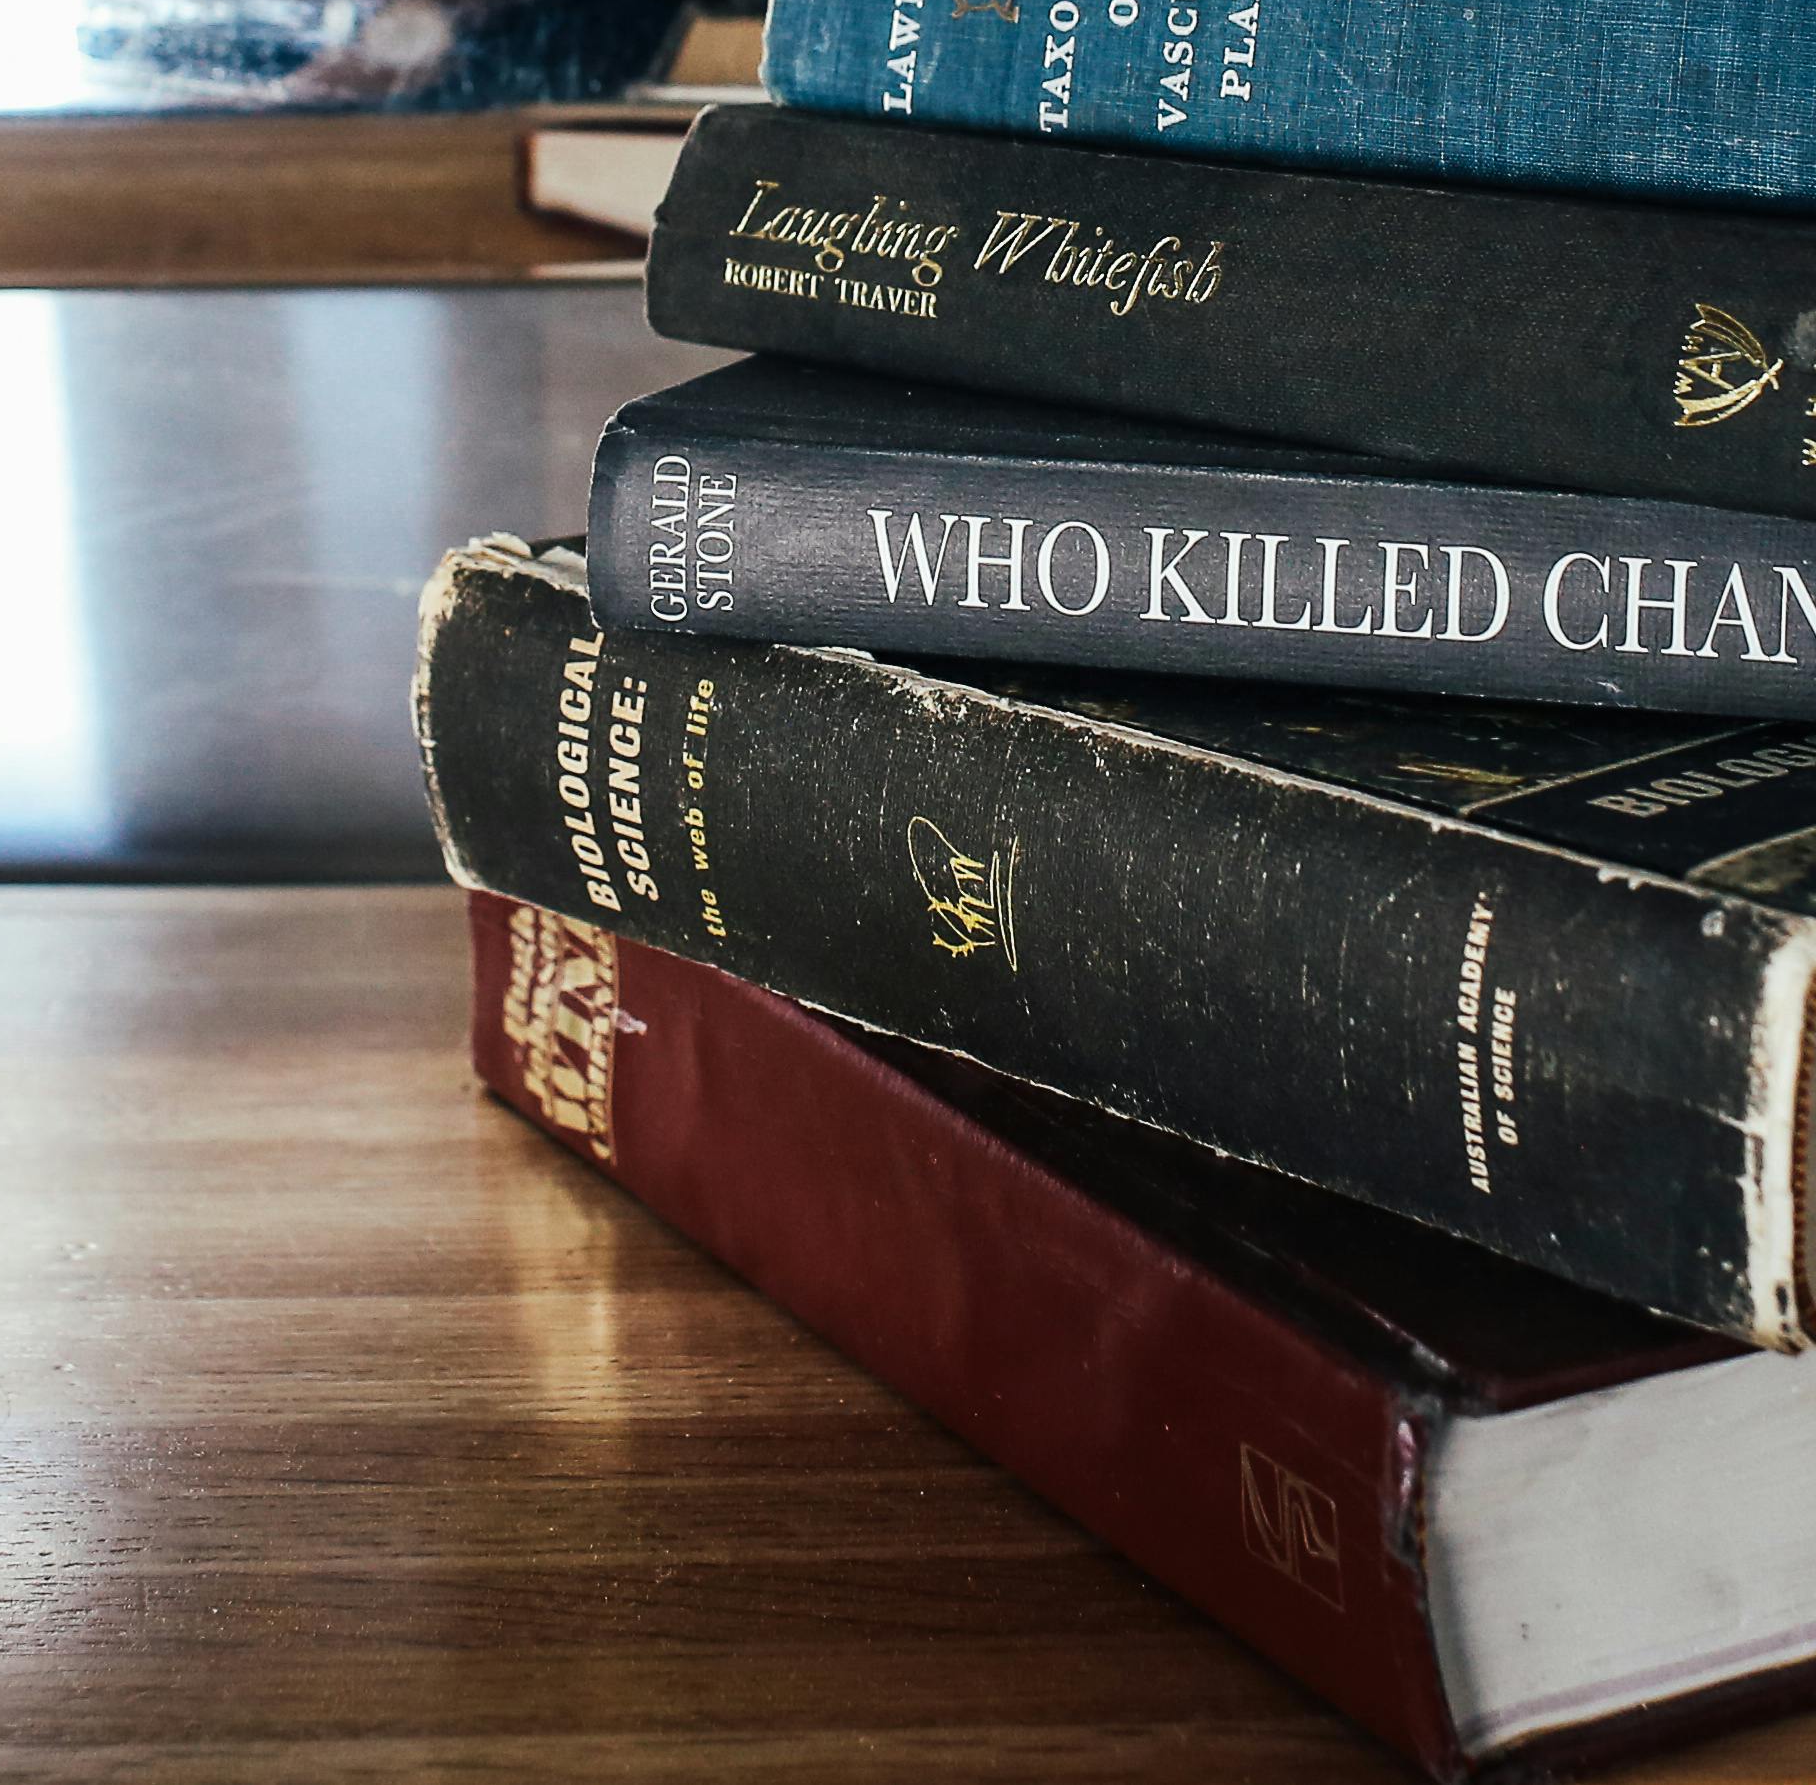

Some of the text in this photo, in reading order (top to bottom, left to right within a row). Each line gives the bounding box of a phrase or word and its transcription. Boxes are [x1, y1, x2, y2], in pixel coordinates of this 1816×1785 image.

[723, 257, 938, 318] ROBERT TRAVER
[729, 179, 1224, 316] Laughing Whitefish
[650, 454, 692, 622] GERALD
[696, 472, 737, 611] STONE
[866, 509, 1112, 616] WHO
[1139, 526, 1511, 643] KILLED
[557, 631, 621, 912] BIOLOGICAL
[608, 676, 659, 902] SCIENCE:
[682, 678, 727, 938] the web of life
[1457, 902, 1495, 1194] AUSTRALIAN ACADEMY
[1491, 986, 1519, 1146] OF SCIENCE
